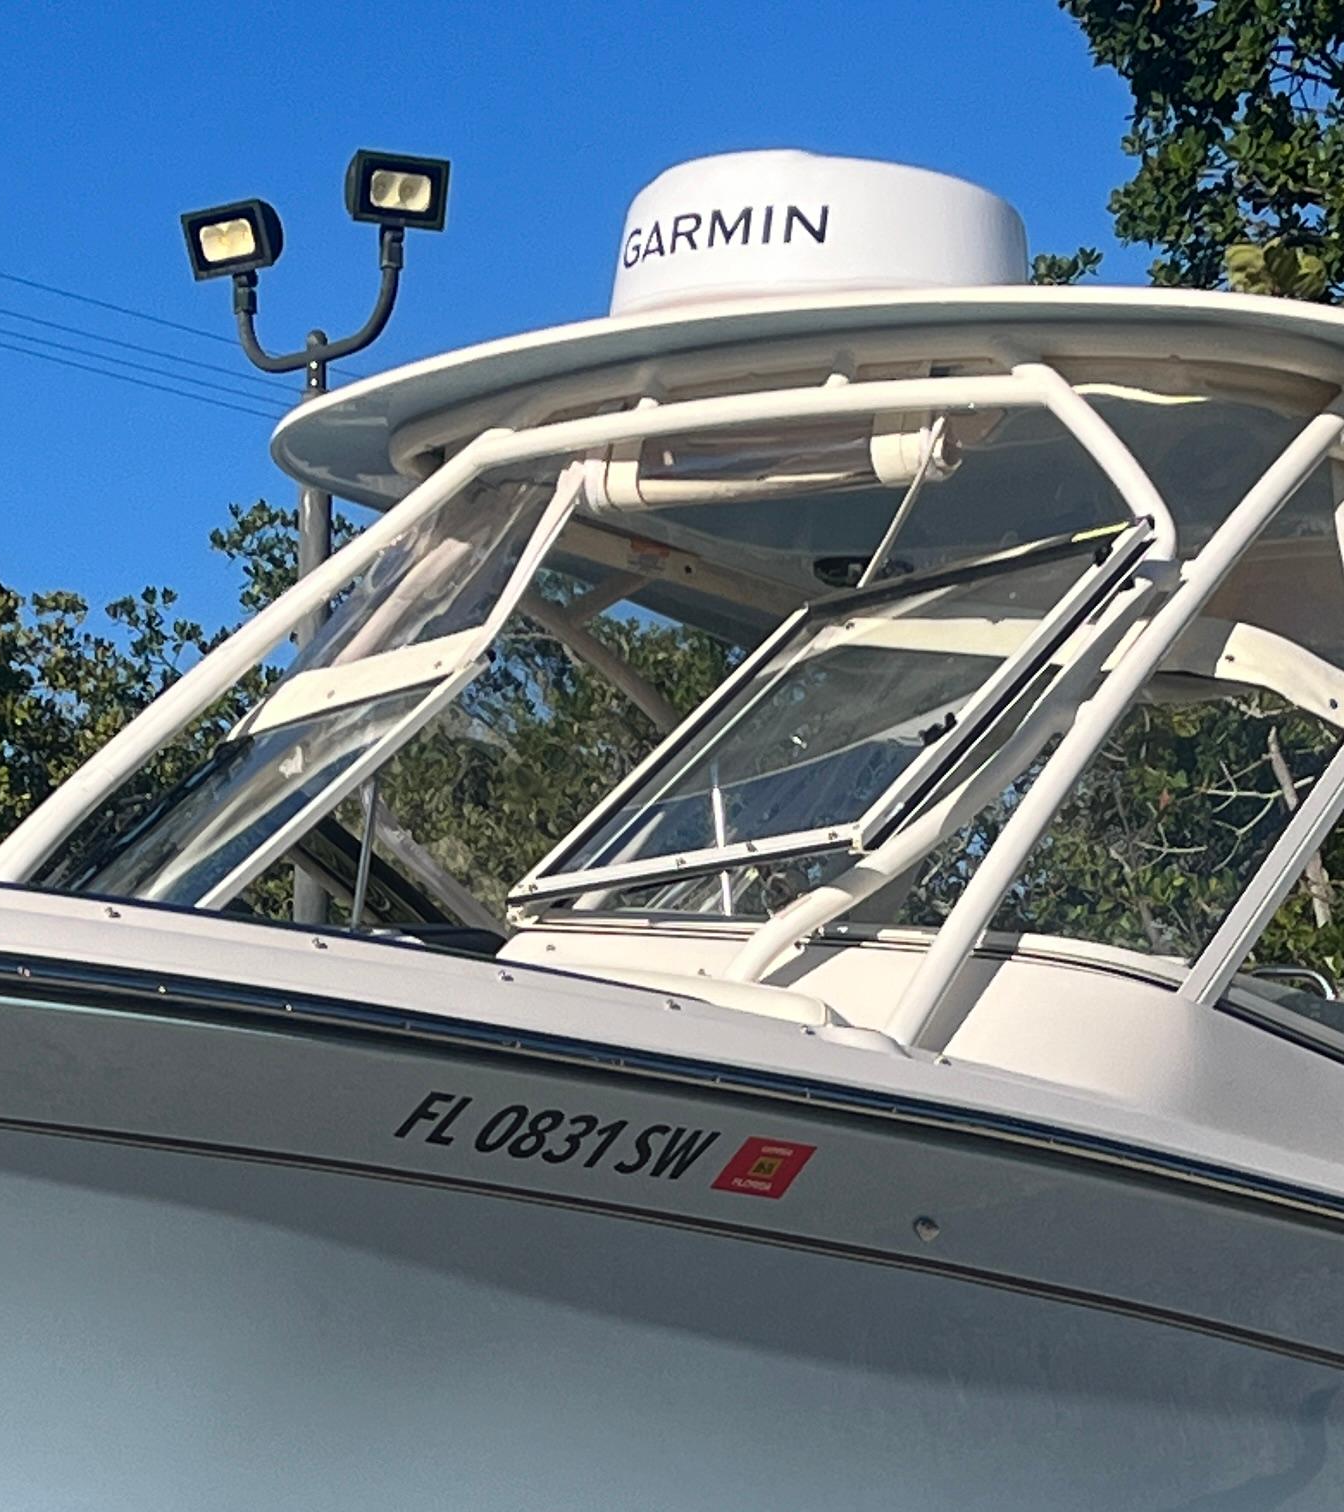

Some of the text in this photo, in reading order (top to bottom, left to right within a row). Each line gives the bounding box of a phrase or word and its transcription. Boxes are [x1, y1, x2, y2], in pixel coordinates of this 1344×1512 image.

[622, 204, 828, 269] GARMIN
[394, 1091, 721, 1180] FL 0831 SW
